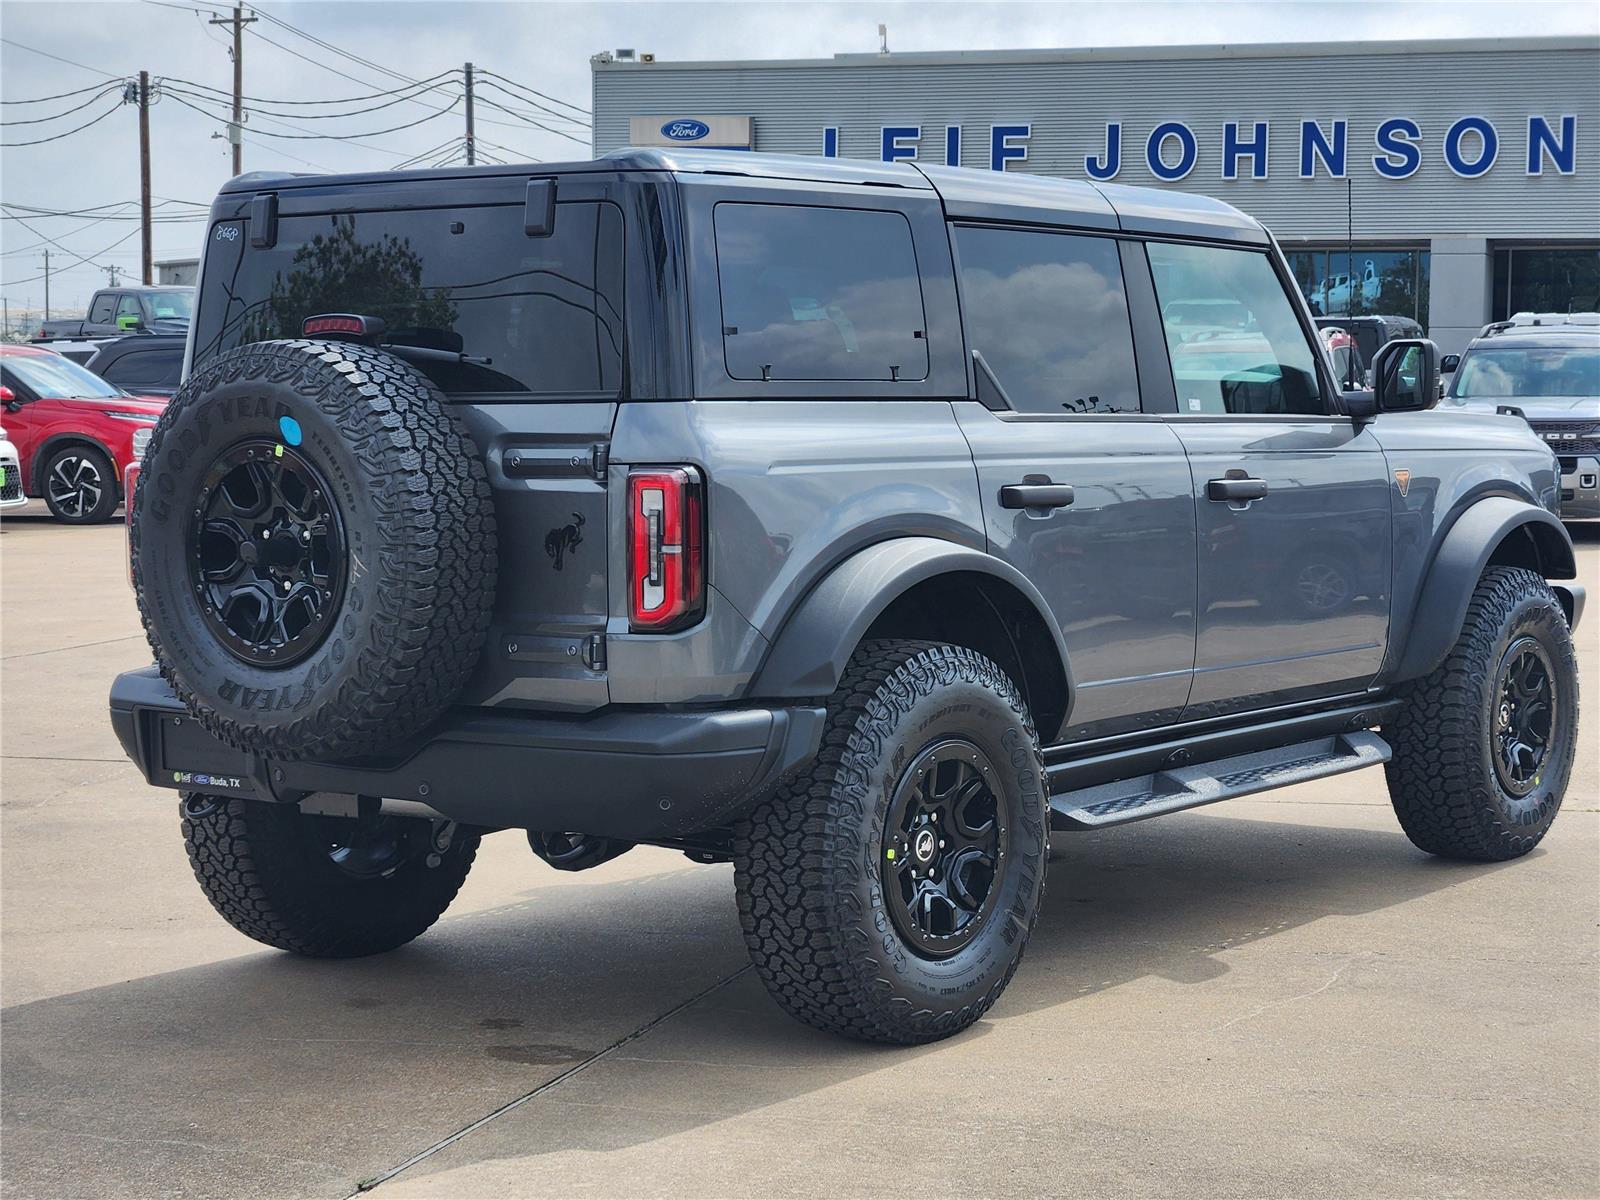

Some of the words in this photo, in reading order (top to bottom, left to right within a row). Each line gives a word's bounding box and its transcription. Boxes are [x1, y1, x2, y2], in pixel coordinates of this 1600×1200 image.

[667, 121, 701, 138] Ford
[1084, 114, 1579, 181] JOHNSON
[210, 776, 228, 787] Buda,
[229, 778, 240, 787] TX
